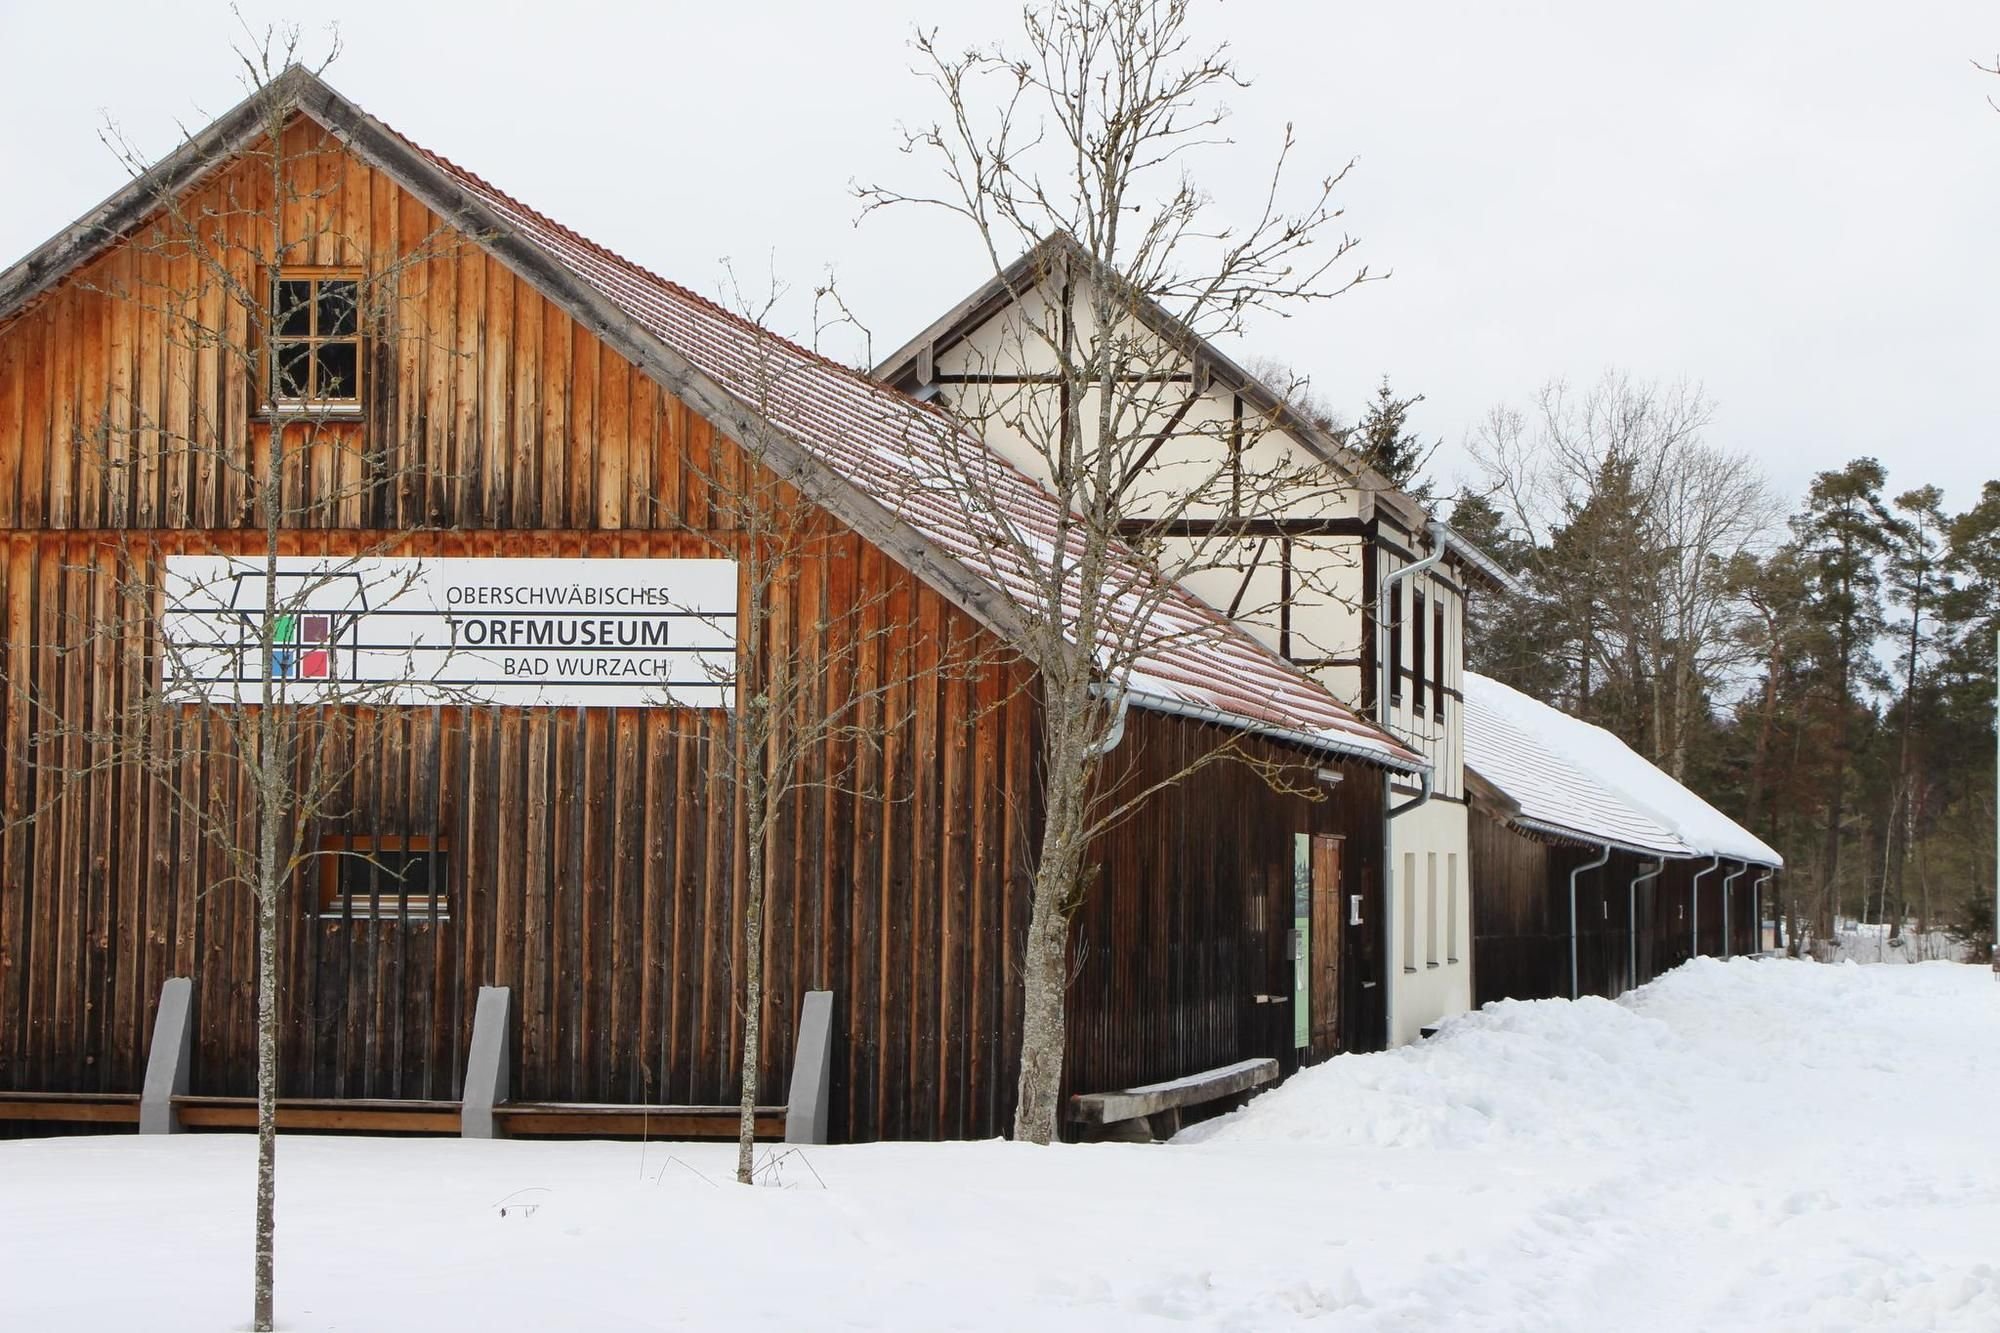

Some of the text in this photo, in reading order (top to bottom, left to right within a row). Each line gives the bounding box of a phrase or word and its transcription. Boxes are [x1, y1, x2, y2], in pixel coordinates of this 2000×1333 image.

[446, 584, 669, 605] OBERSCHWÄBISCHES
[445, 619, 669, 646] TORFMUSEUM
[504, 658, 667, 677] BAD WURZACH
